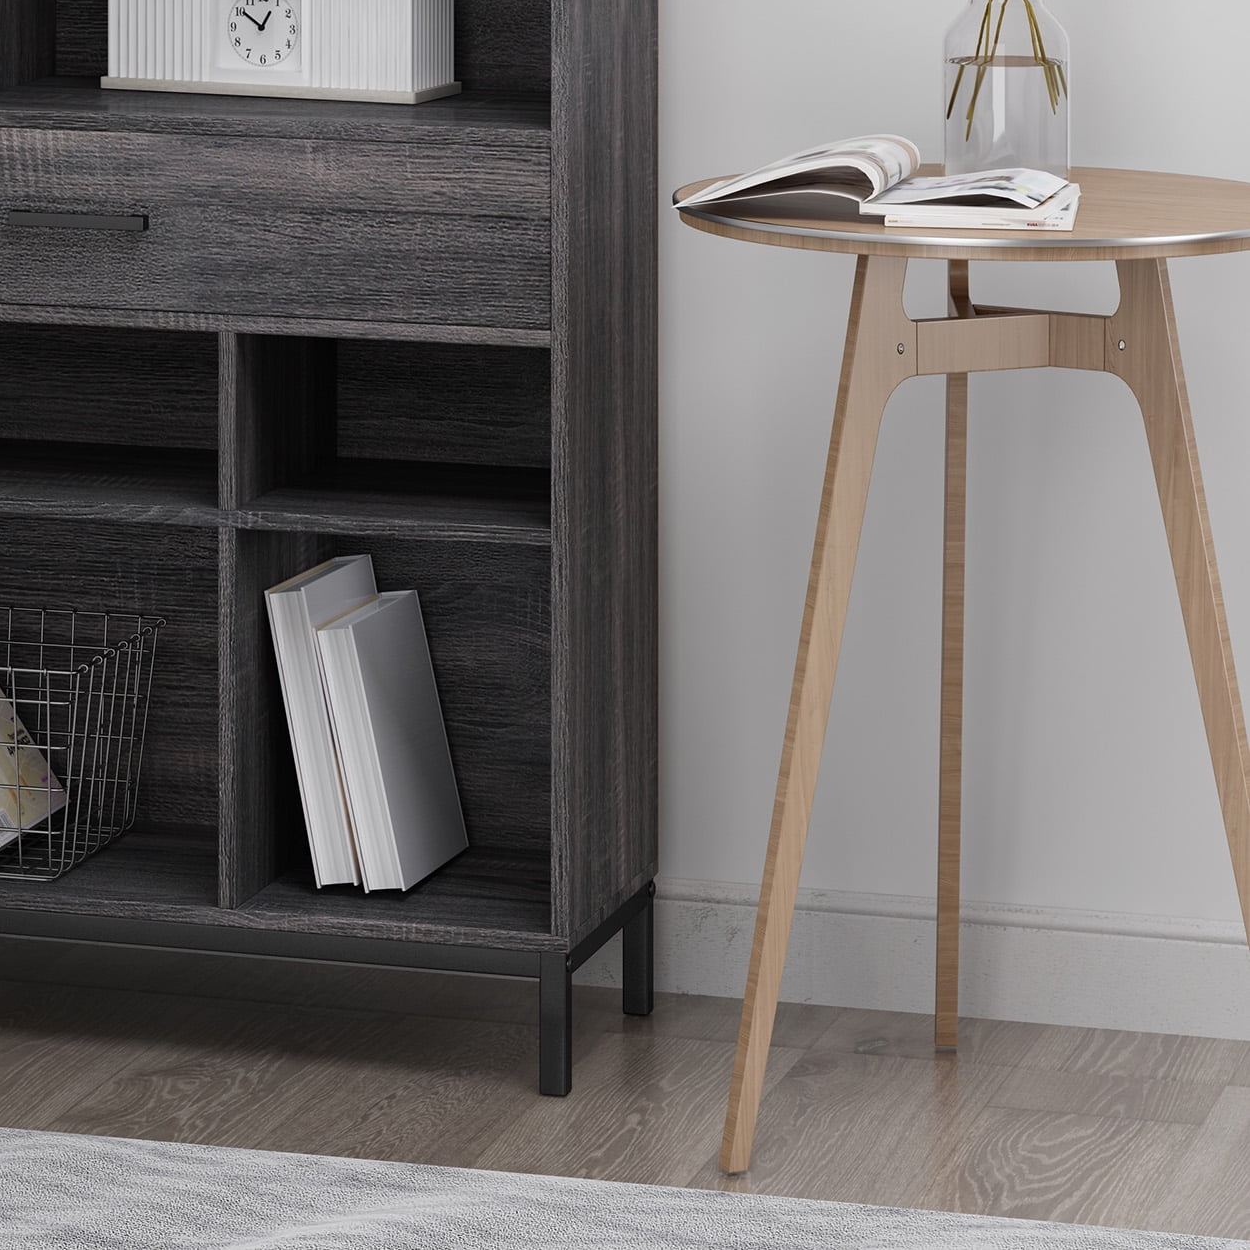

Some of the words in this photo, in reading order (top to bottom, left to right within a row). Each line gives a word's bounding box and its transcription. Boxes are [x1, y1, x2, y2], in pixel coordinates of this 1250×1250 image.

[235, 6, 246, 17] 10
[285, 8, 292, 19] 2
[230, 21, 237, 32] 9
[289, 24, 296, 35] 3
[234, 36, 241, 47] 8
[285, 38, 292, 49] 4
[245, 48, 252, 59] 7
[275, 50, 281, 60] 5
[259, 54, 266, 65] 6
